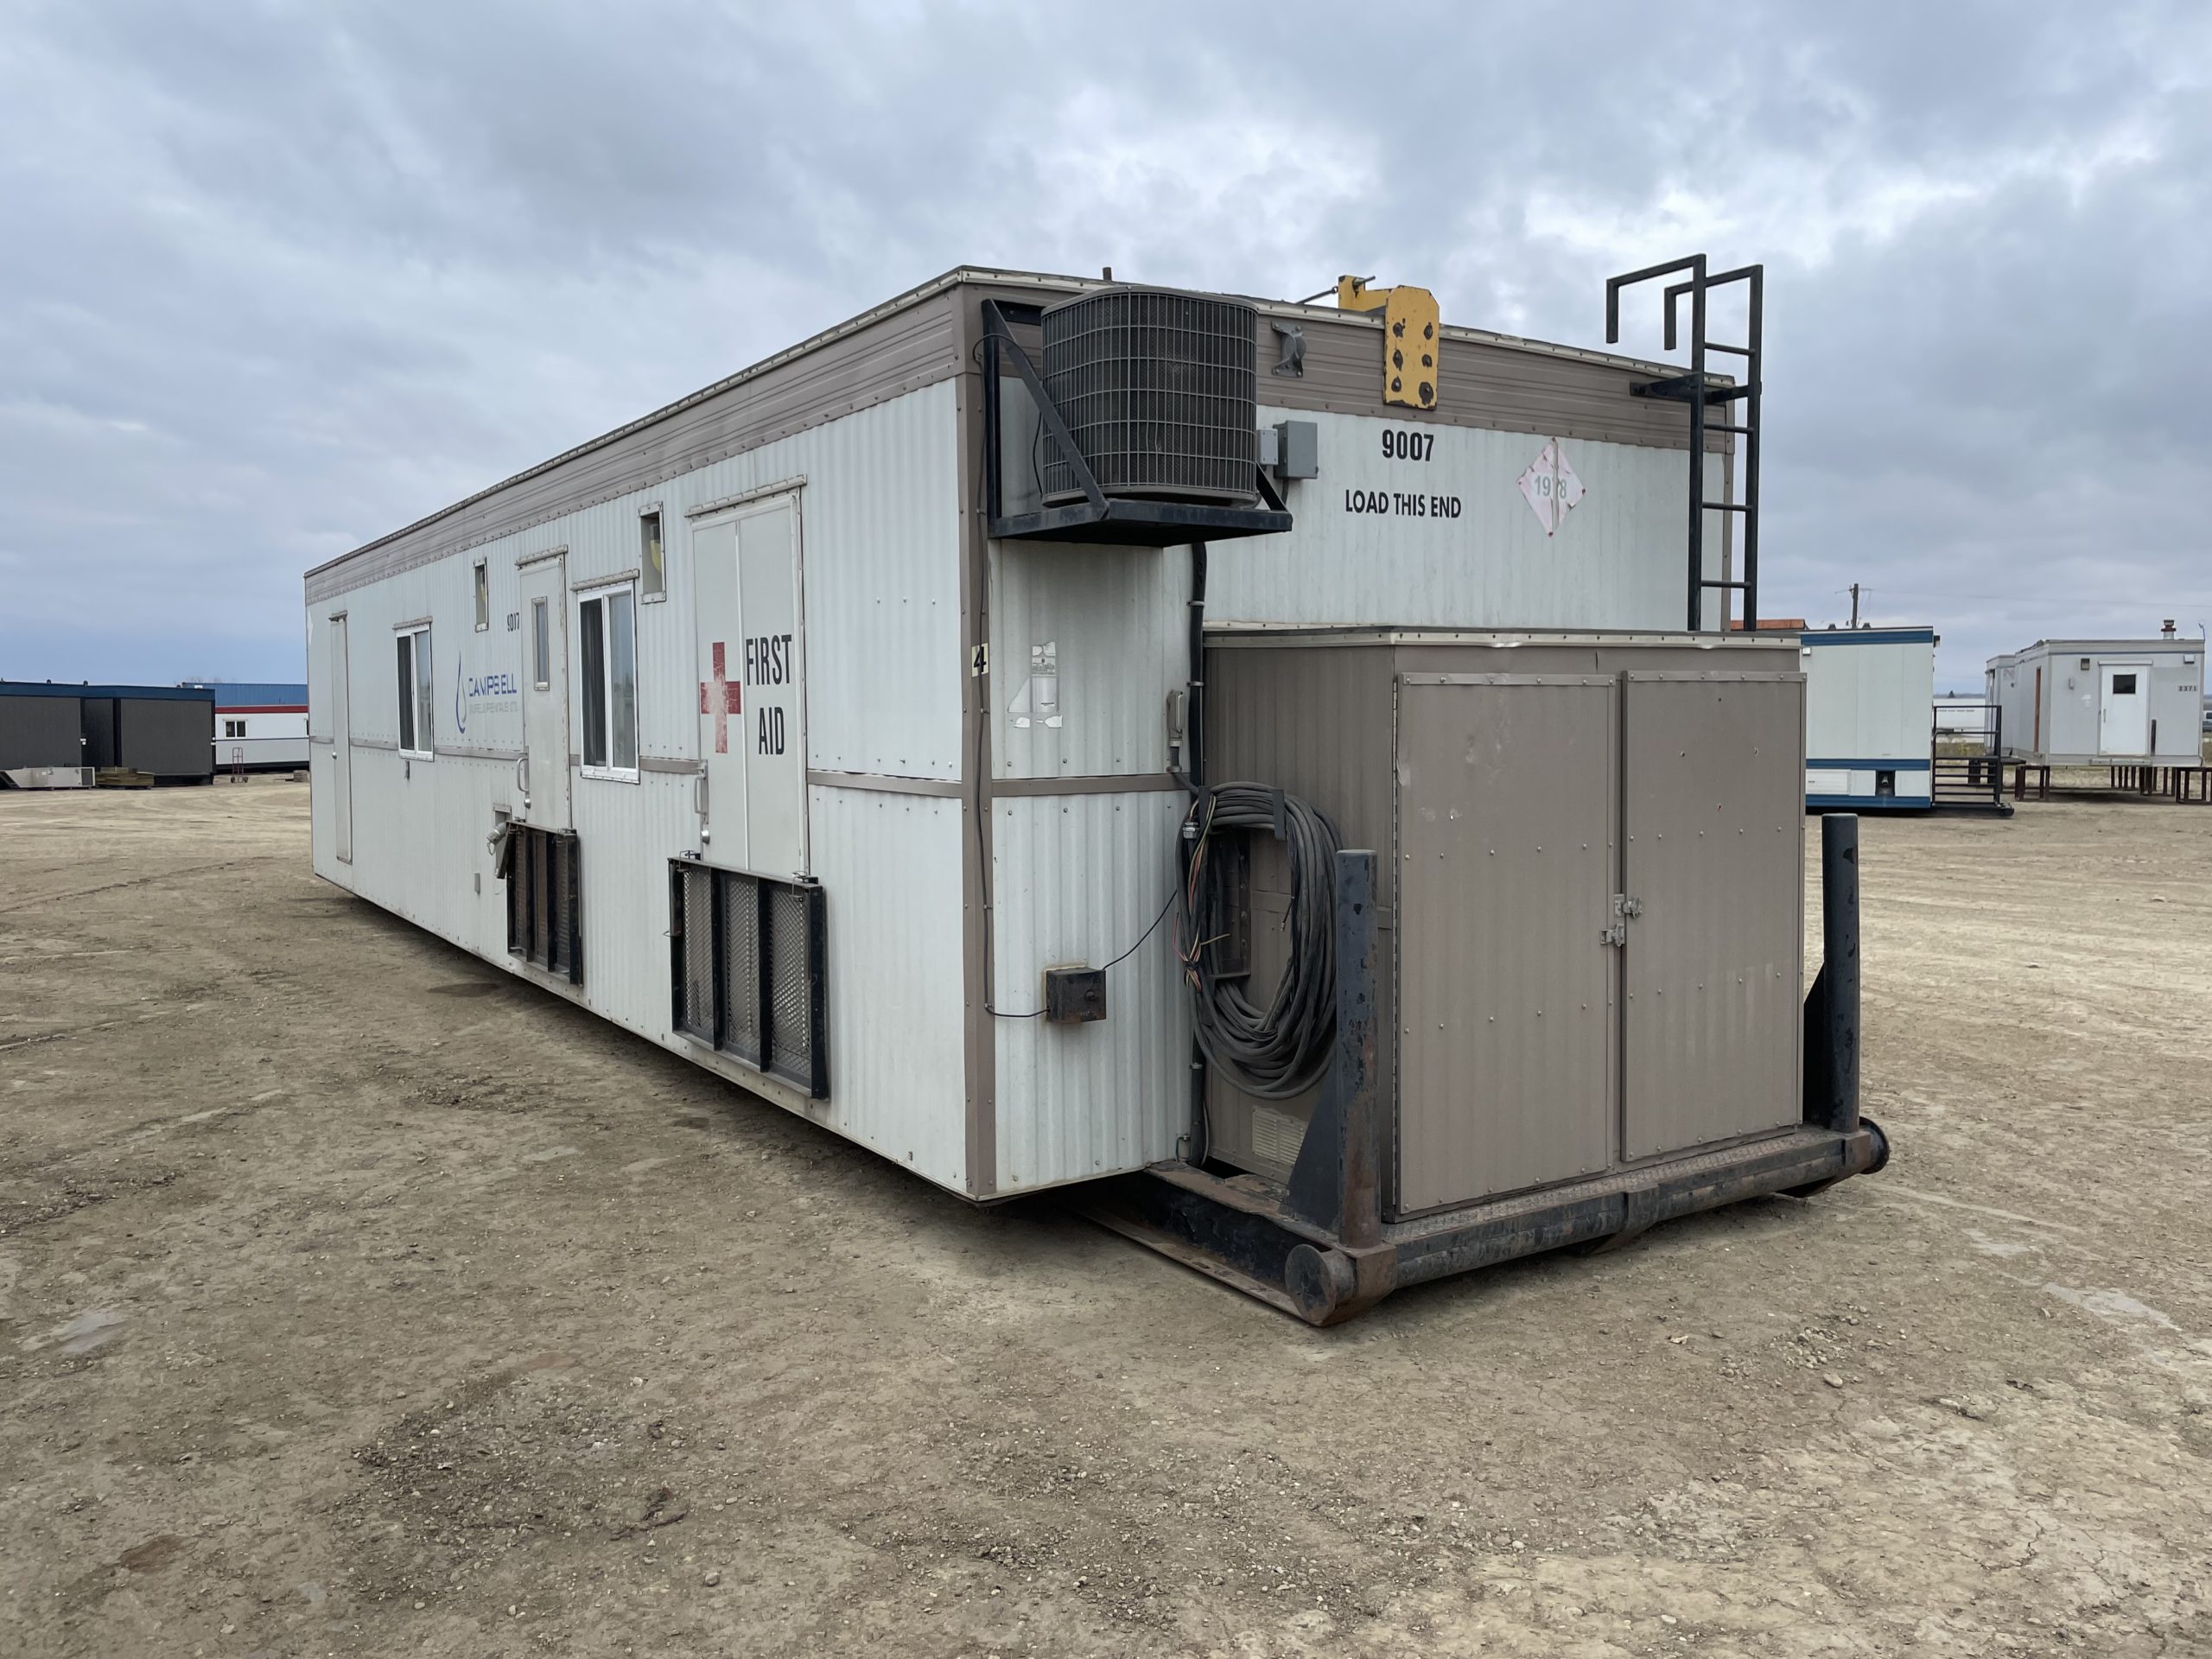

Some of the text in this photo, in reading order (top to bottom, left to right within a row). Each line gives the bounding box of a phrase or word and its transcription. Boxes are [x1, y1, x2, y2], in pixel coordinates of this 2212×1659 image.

[1382, 429, 1434, 461] 9007
[1535, 475, 1567, 499] 198
[1345, 489, 1461, 518] LOAD THIS END
[746, 634, 792, 685] FIRST
[973, 646, 987, 673] 4
[468, 673, 517, 696] CAMPBELL
[758, 707, 785, 755] AID
